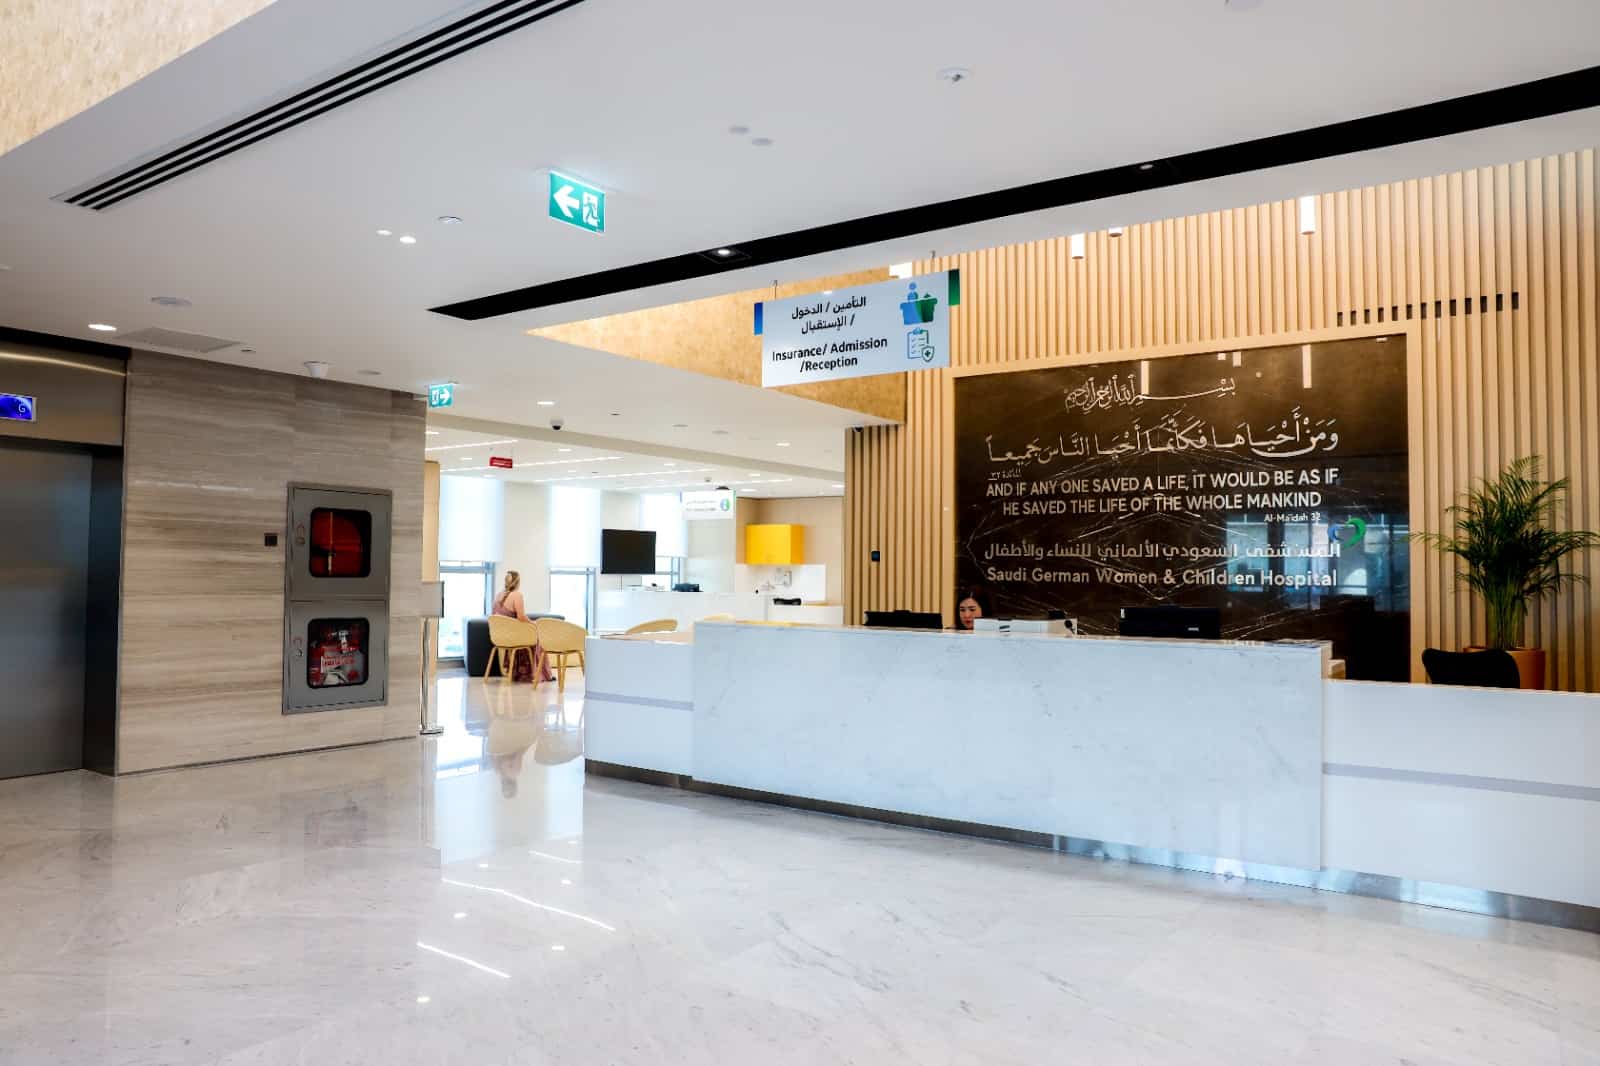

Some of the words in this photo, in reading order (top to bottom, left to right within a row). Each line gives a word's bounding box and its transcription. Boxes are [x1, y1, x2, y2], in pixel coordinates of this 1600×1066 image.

[792, 303, 822, 320] الدخول
[825, 301, 830, 313] /
[833, 296, 867, 313] التأمين
[802, 316, 846, 334] الإستقبال
[850, 313, 856, 326] /
[772, 344, 827, 362] Insurance/
[830, 336, 888, 354] Admission
[800, 356, 858, 373] /Reception
[986, 482, 1013, 497] AND
[1016, 482, 1027, 496] IF
[1030, 481, 1057, 495] ANY
[1061, 479, 1089, 494] ONE
[1092, 477, 1140, 492] SAVED
[1143, 476, 1154, 490] A
[1157, 474, 1189, 491] LIFE,
[1193, 473, 1206, 488] IT
[1210, 471, 1270, 488] WOULD
[1274, 470, 1294, 486] BE
[1298, 468, 1320, 485] AS
[1325, 468, 1339, 484] IF
[1003, 501, 1020, 516] HE
[1022, 500, 1067, 515] SAVED
[1070, 499, 1096, 514] THE
[1100, 498, 1127, 513] LIFE
[1130, 497, 1150, 512] OF
[1154, 495, 1182, 511] THE
[1186, 494, 1242, 510] WHOLE
[1247, 491, 1321, 508] MANKIND
[985, 540, 1044, 560] والأطفال
[1047, 543, 1091, 557] للنساء
[1097, 540, 1159, 561] الألماني
[1163, 543, 1237, 561] السعودي
[1246, 541, 1341, 558] المستشفى
[987, 567, 1027, 582] Saudi
[1032, 567, 1089, 583] German
[1096, 567, 1157, 584] Women
[1163, 569, 1176, 585] &
[1183, 568, 1255, 586] Children
[1260, 570, 1337, 590] Hospital
